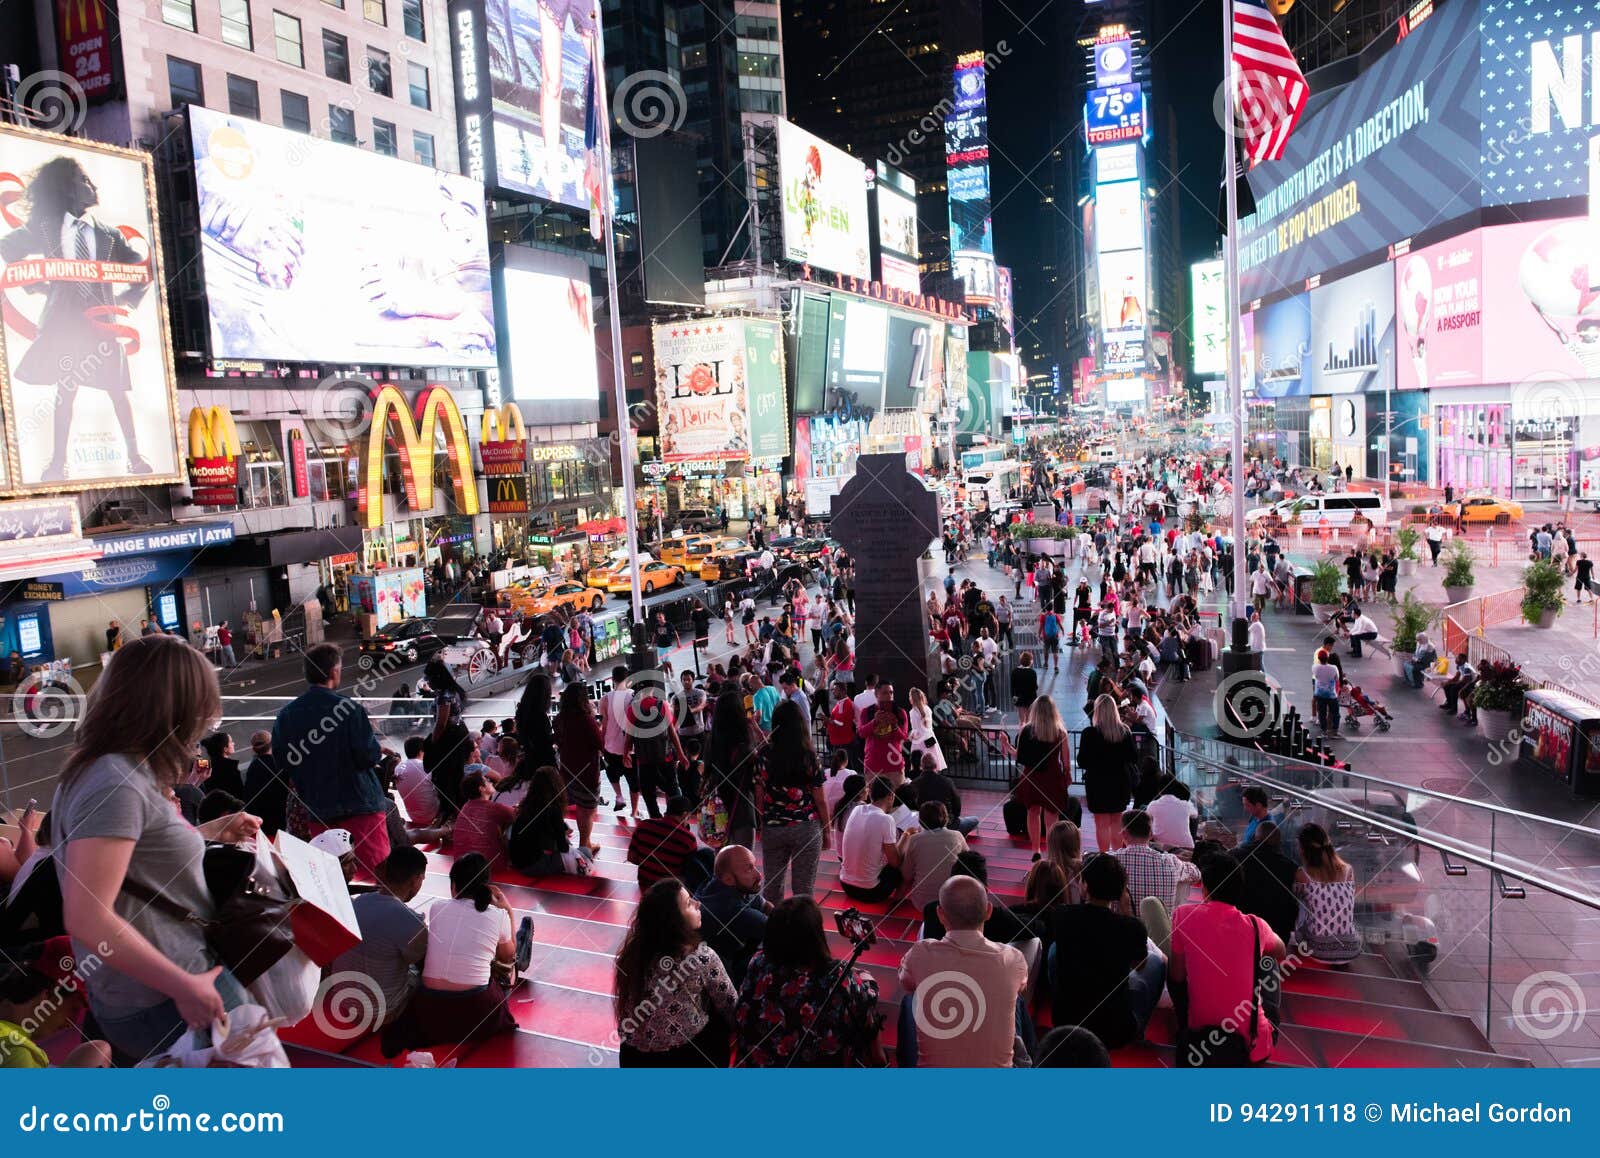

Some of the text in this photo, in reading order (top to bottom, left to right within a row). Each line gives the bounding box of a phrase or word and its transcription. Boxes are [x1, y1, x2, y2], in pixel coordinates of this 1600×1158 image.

[70, 37, 103, 56] OPEN
[1095, 33, 1131, 46] TOSHIBA
[75, 52, 101, 77] 24
[457, 9, 479, 101] EXPRESS
[1089, 126, 1143, 143] TOSHIBA
[465, 114, 485, 182] EXPRE
[1256, 188, 1277, 228] THINK
[1278, 168, 1306, 208] NORTH
[1306, 148, 1331, 193] WEST
[1332, 143, 1343, 177] IS
[1345, 133, 1354, 170] A
[1355, 80, 1429, 163] DIRECTION,
[1250, 235, 1267, 267] NEED
[1268, 228, 1278, 258] TO
[1278, 220, 1289, 254] BE
[1290, 211, 1305, 248] POP
[1307, 179, 1361, 239] CULTURED.
[6, 261, 99, 283] FINAL MONTHS
[885, 284, 964, 318] BROADWAY
[1437, 310, 1481, 333] A PASSPORT
[73, 444, 123, 464] Matilda
[532, 444, 577, 461] EXPRESS
[190, 465, 235, 478] McDonald's
[91, 527, 232, 555] HANGE MONEY ATM
[82, 563, 158, 581] MONEY EXCHANGE
[23, 591, 62, 600] EXCHANGE
